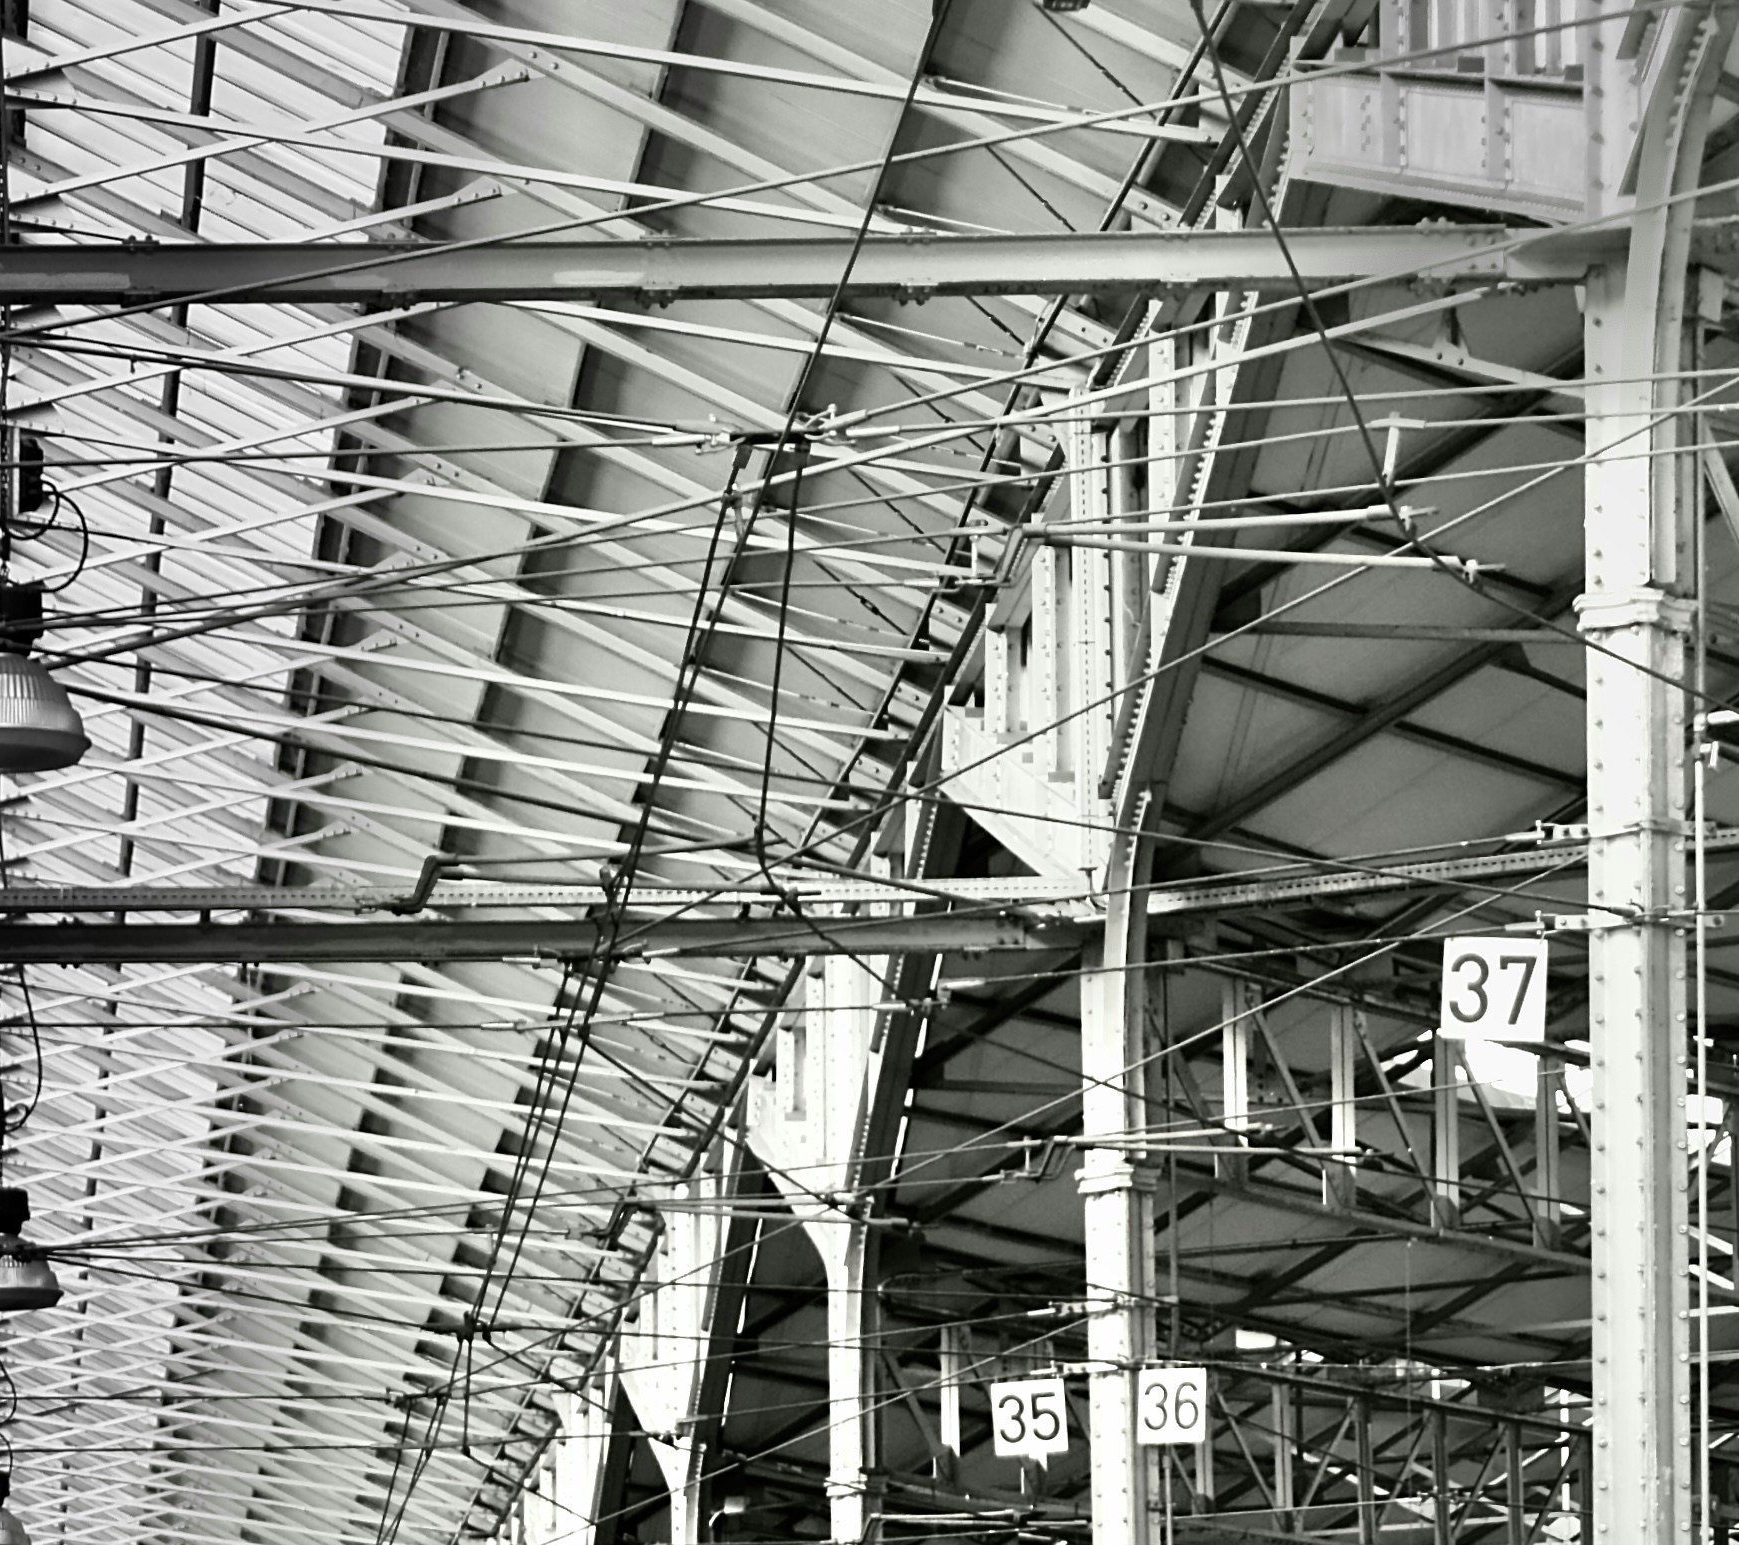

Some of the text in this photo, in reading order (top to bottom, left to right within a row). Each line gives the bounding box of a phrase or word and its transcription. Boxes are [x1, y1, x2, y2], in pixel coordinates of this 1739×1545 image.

[1449, 953, 1537, 1025] 37
[998, 1391, 1060, 1443] 35
[1143, 1381, 1198, 1430] 36
